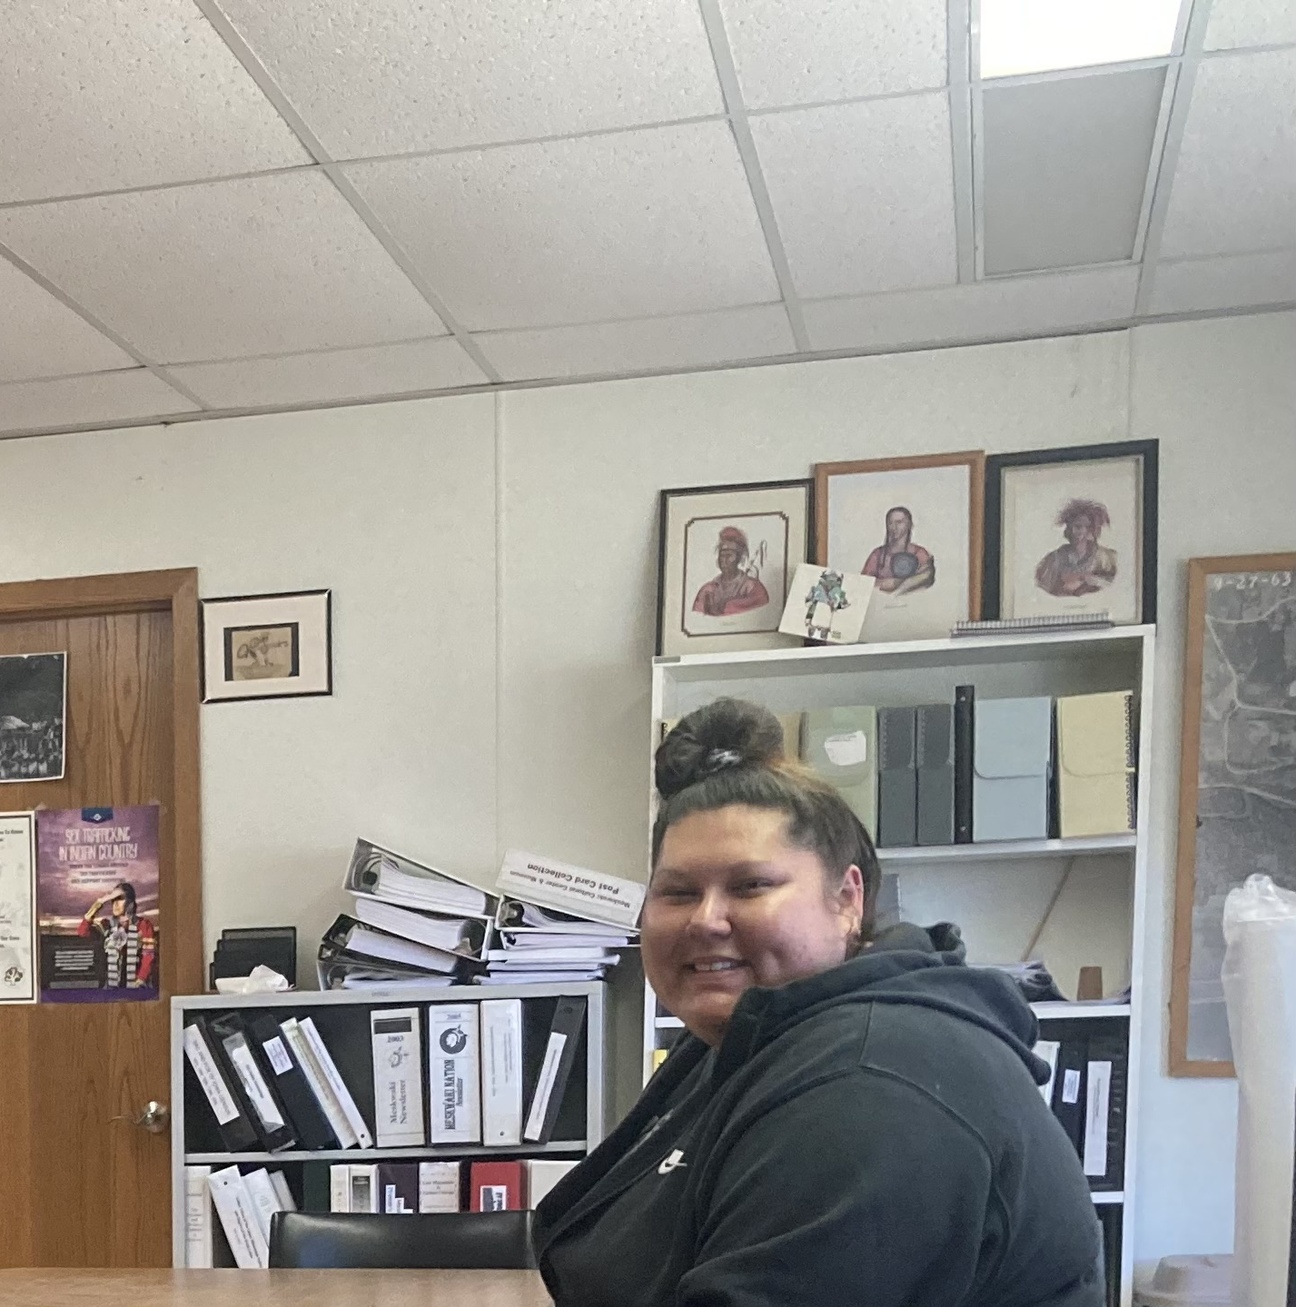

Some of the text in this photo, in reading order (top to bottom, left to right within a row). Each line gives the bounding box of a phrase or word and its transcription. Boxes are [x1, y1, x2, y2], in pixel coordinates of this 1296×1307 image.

[65, 826, 131, 843] SEX TRAFFICKING
[59, 843, 138, 861] IN INDIAN COUNTRY
[527, 863, 620, 895] Post Card Collection
[545, 880, 568, 891] Center
[388, 1081, 397, 1124] Meskwaki
[399, 1079, 407, 1124] Newsletter
[443, 1059, 455, 1130] MESKWAKI NATION
